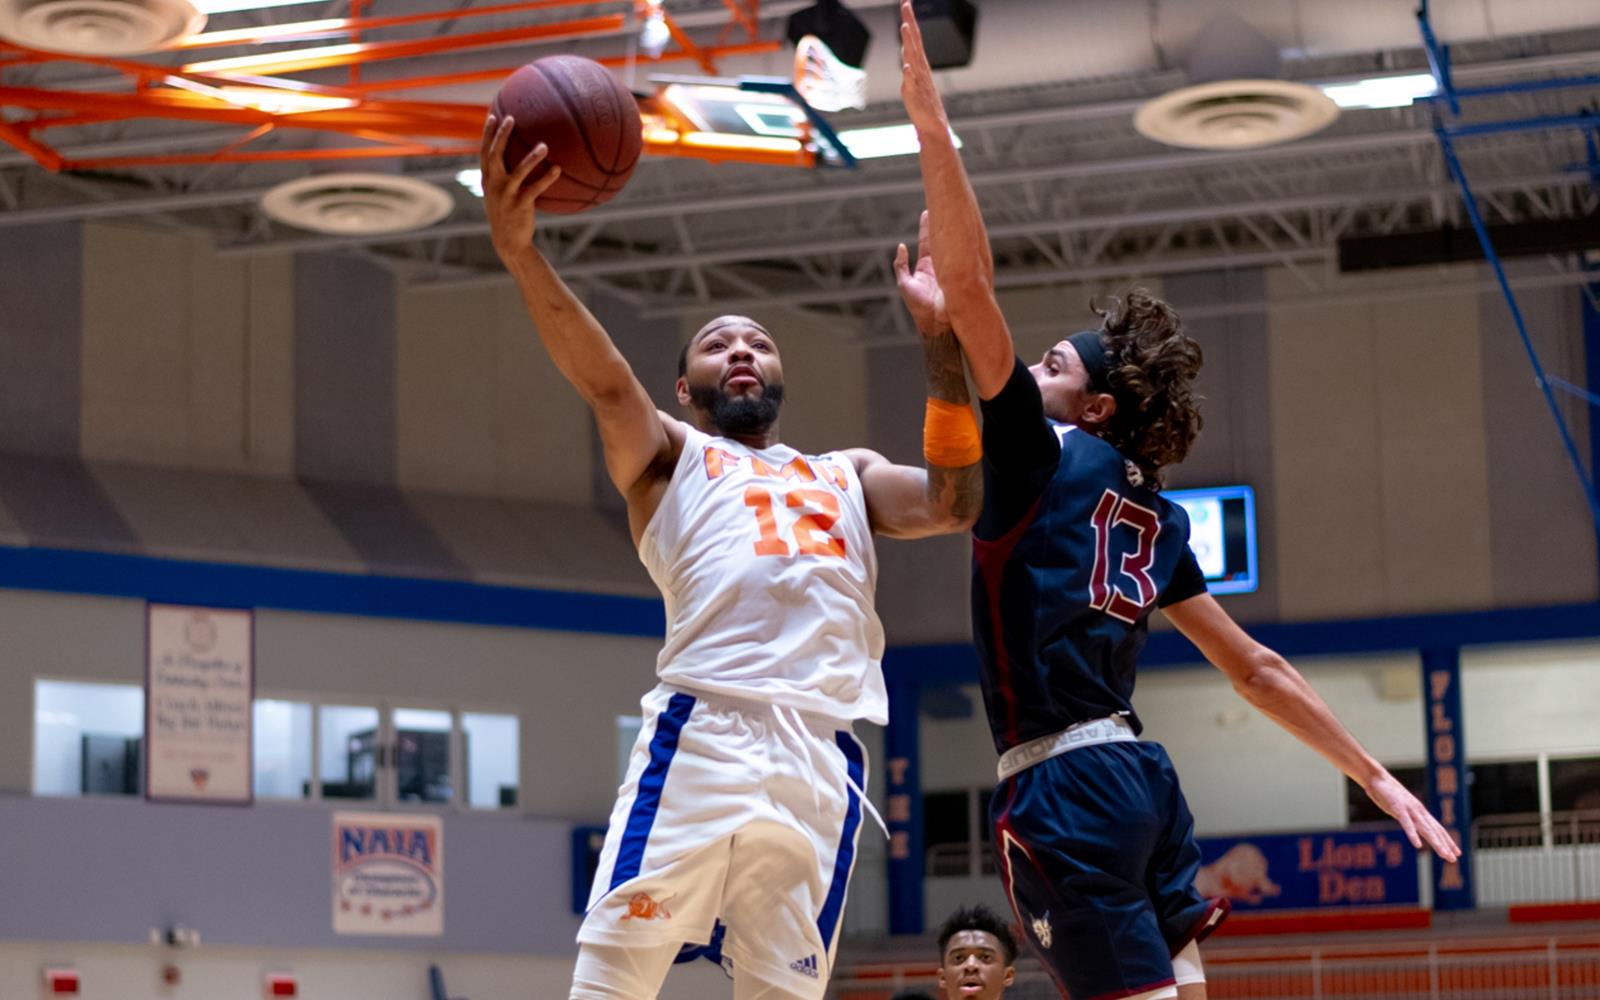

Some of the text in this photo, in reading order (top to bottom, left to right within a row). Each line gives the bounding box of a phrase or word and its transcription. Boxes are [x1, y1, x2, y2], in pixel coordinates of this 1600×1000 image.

[703, 446, 848, 491] FMU
[744, 487, 845, 558] 12
[1089, 489, 1160, 623] 13
[889, 758, 910, 859] THE
[342, 827, 432, 864] NAIA
[1298, 836, 1403, 872] Lion's
[1319, 873, 1385, 903] Den
